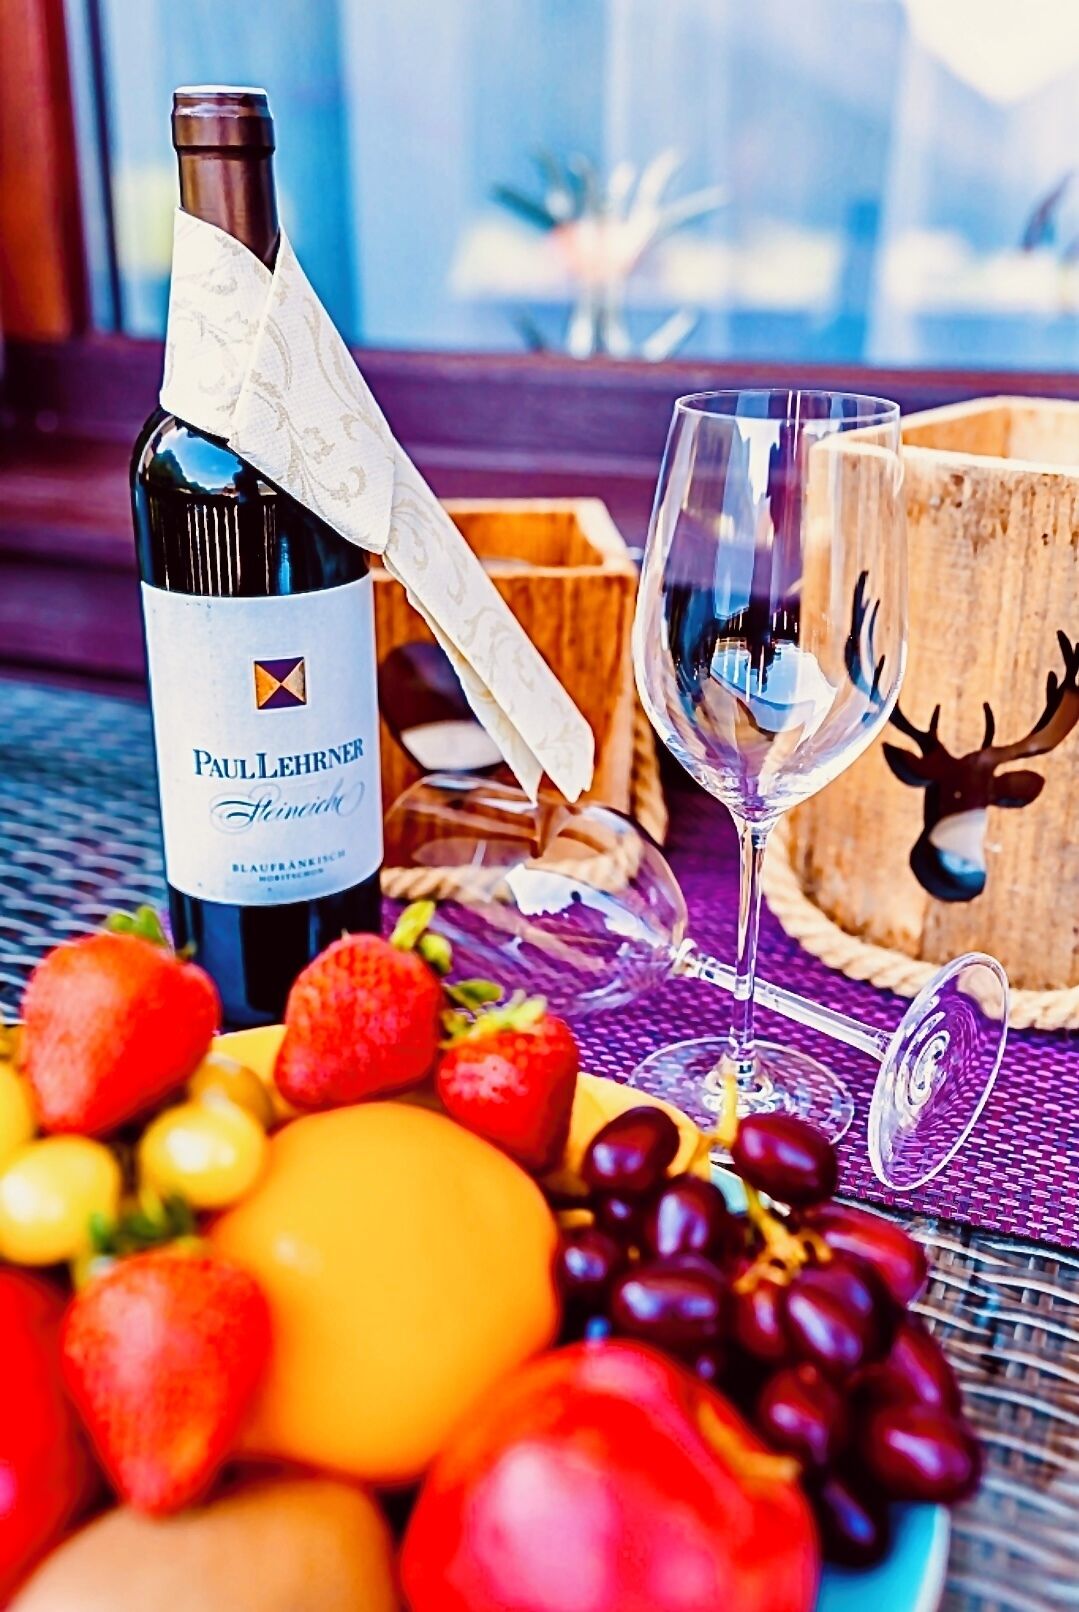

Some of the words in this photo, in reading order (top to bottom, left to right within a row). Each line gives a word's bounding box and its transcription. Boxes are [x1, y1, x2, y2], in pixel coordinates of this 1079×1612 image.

[193, 749, 255, 779] PAUL
[256, 738, 364, 779] LEHRNER
[232, 850, 346, 873] BLAUFRÄNKISCH
